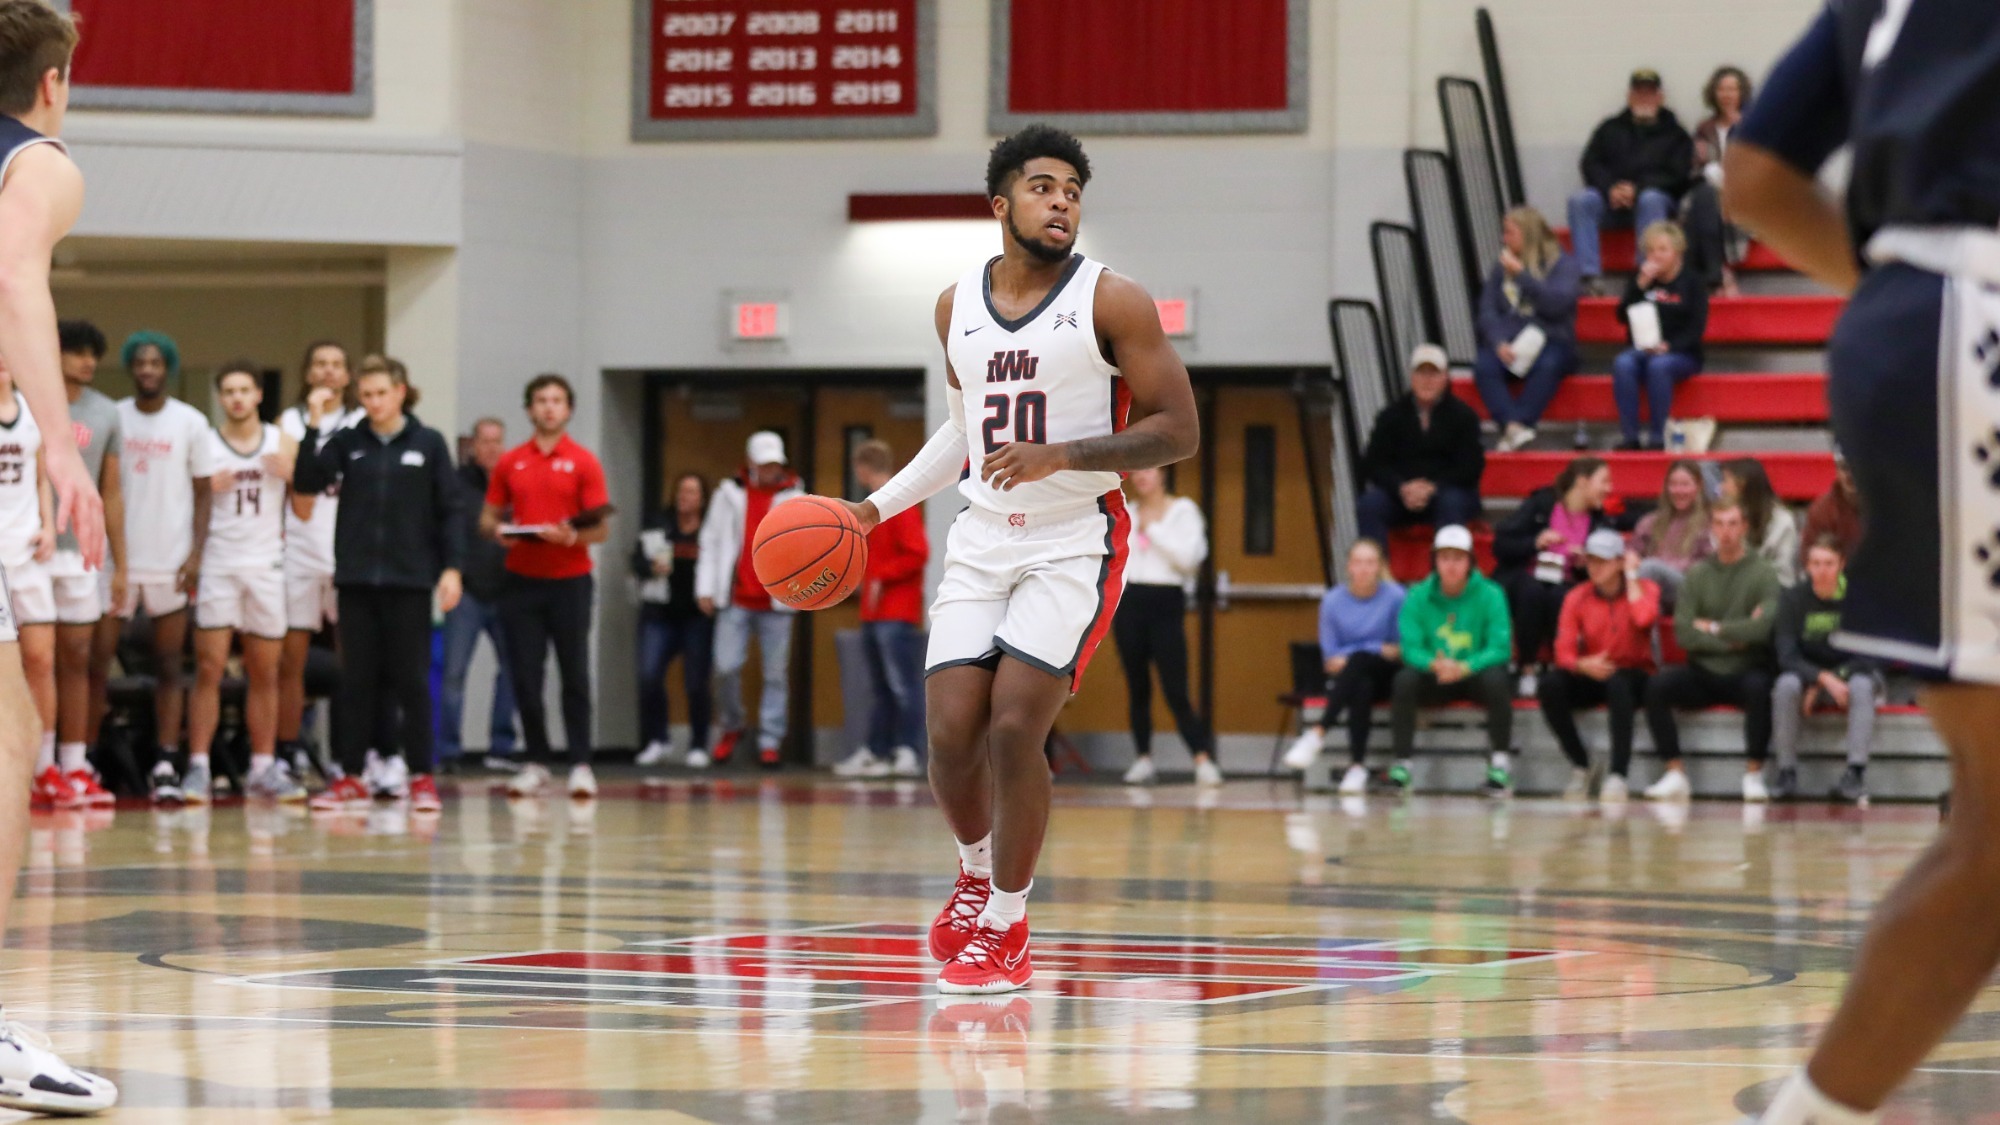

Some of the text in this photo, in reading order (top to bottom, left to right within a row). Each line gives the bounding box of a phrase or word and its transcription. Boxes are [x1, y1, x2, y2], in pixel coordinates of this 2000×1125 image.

[663, 12, 736, 36] 2007
[835, 10, 898, 33] 2011
[665, 45, 901, 72] 2012 2013 2014
[665, 81, 901, 107] 2015 2016 2019
[986, 349, 1039, 383] IWU
[982, 391, 1047, 454] 20
[236, 487, 260, 515] 14
